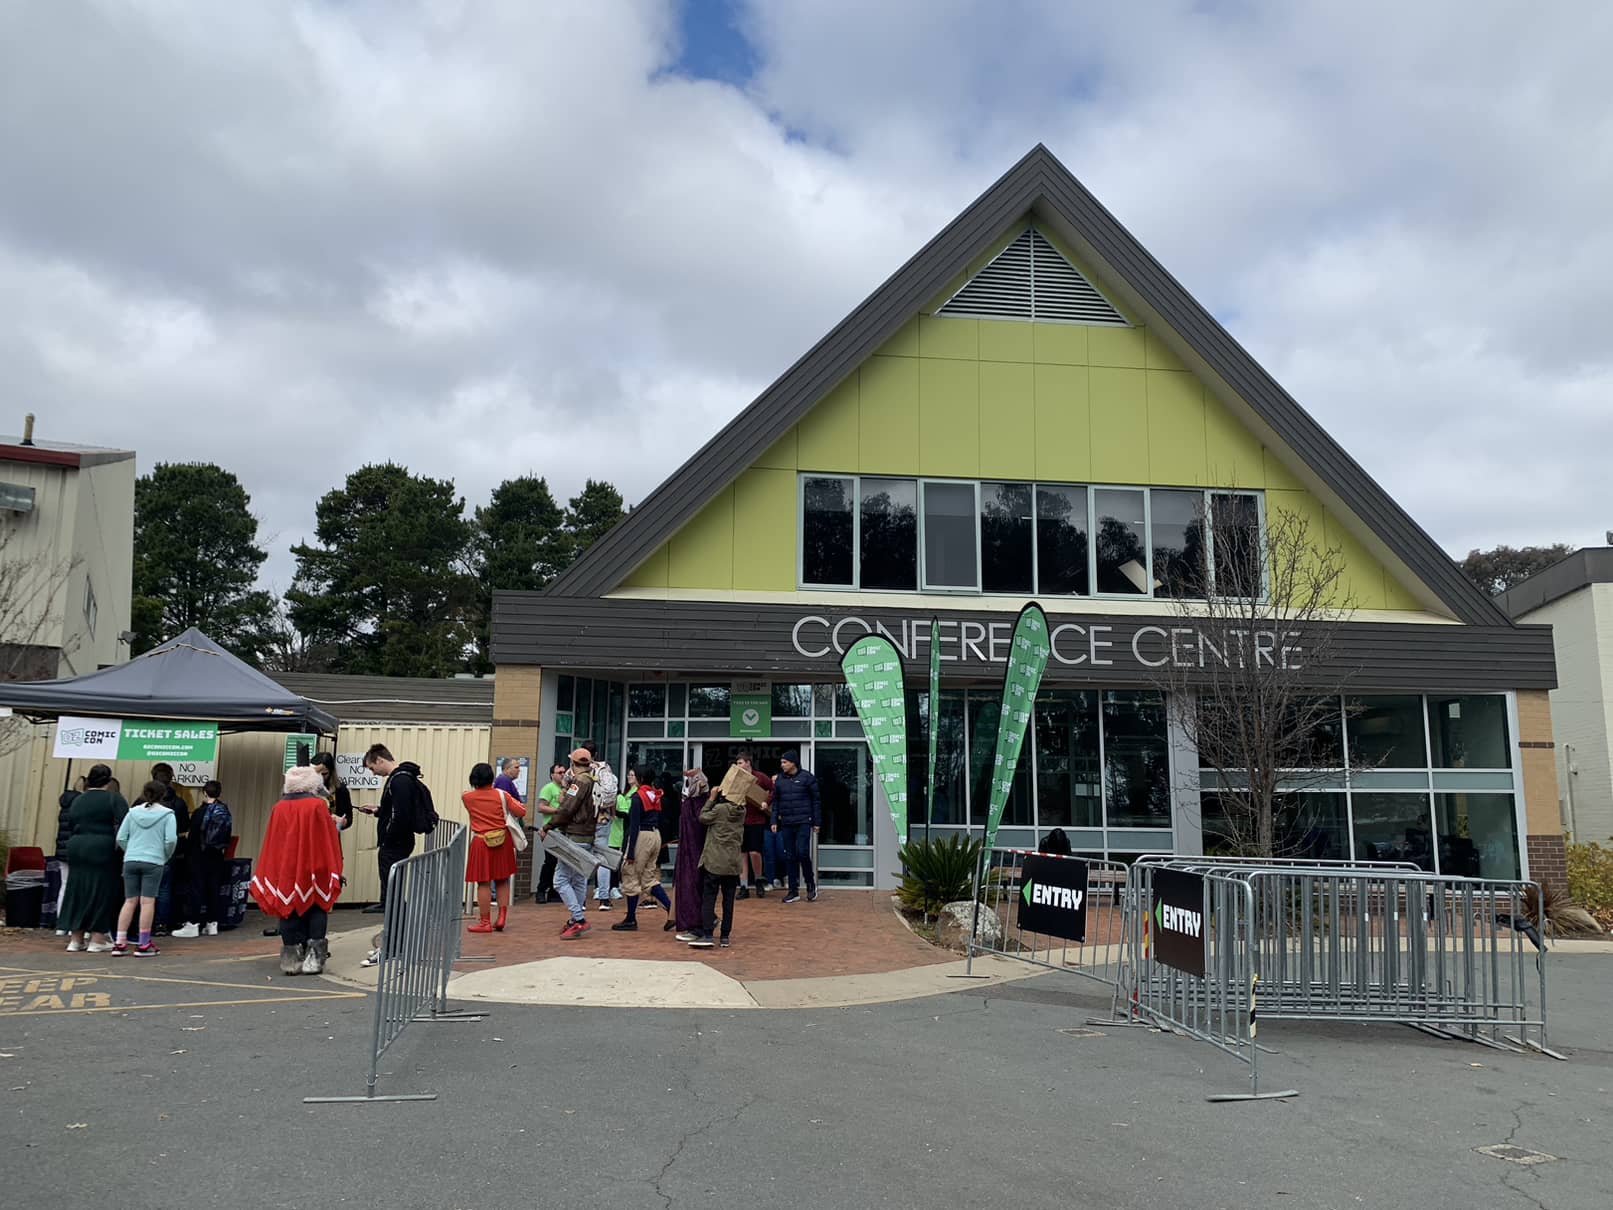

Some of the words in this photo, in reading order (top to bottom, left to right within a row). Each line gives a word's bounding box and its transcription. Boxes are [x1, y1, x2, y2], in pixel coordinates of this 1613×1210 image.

[792, 615, 1113, 666] CONFERECE
[1131, 625, 1303, 670] CENTRE
[85, 730, 116, 739] COMIC
[124, 728, 172, 740] TICKET
[174, 729, 214, 740] SALES
[83, 737, 103, 745] CON
[336, 754, 361, 764] Clear
[179, 763, 196, 773] NO
[349, 765, 366, 775] NO
[171, 775, 210, 784] ARKING
[1032, 882, 1083, 911] ENTRY
[1162, 903, 1201, 938] ENTRY
[0, 977, 98, 993] EEP
[0, 992, 112, 1011] EAR
